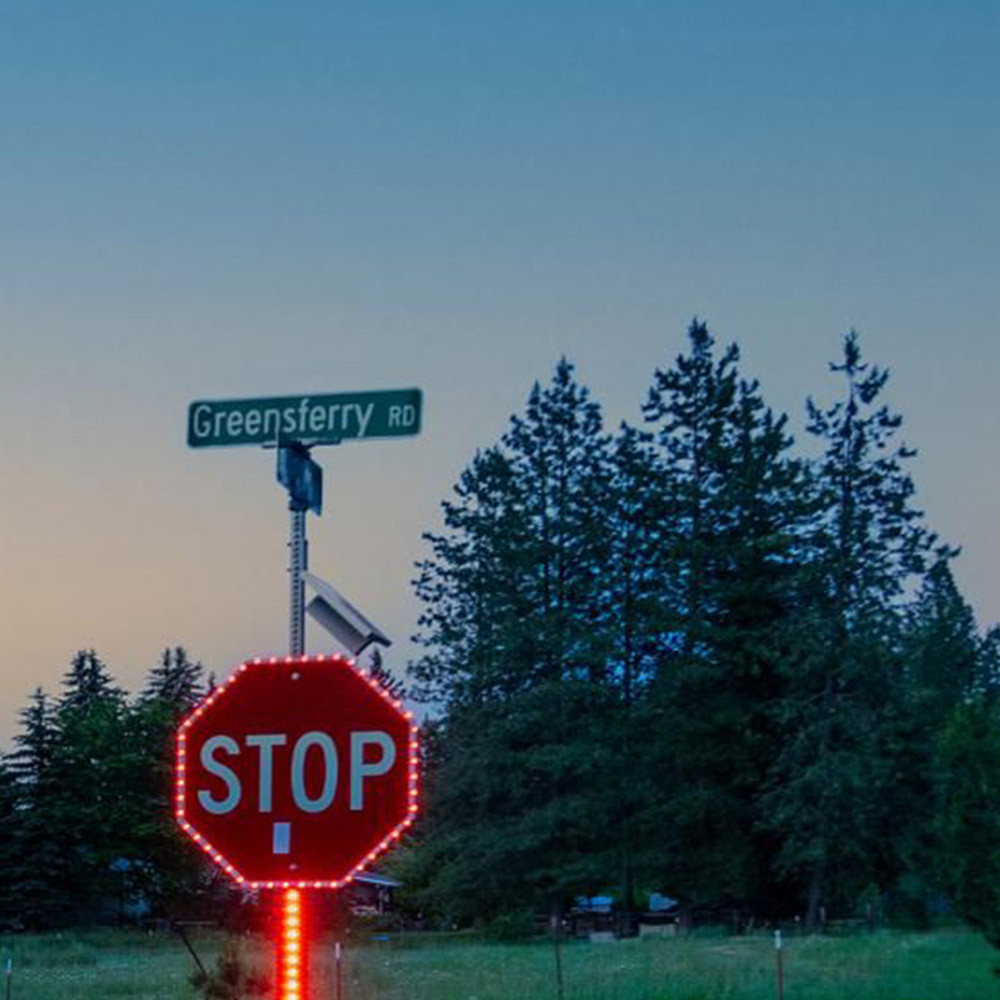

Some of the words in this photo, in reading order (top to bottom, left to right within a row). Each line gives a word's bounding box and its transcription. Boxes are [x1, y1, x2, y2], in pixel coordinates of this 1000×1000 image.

[193, 399, 374, 438] Greensferry
[388, 405, 416, 427] RD
[197, 731, 397, 815] STOP
